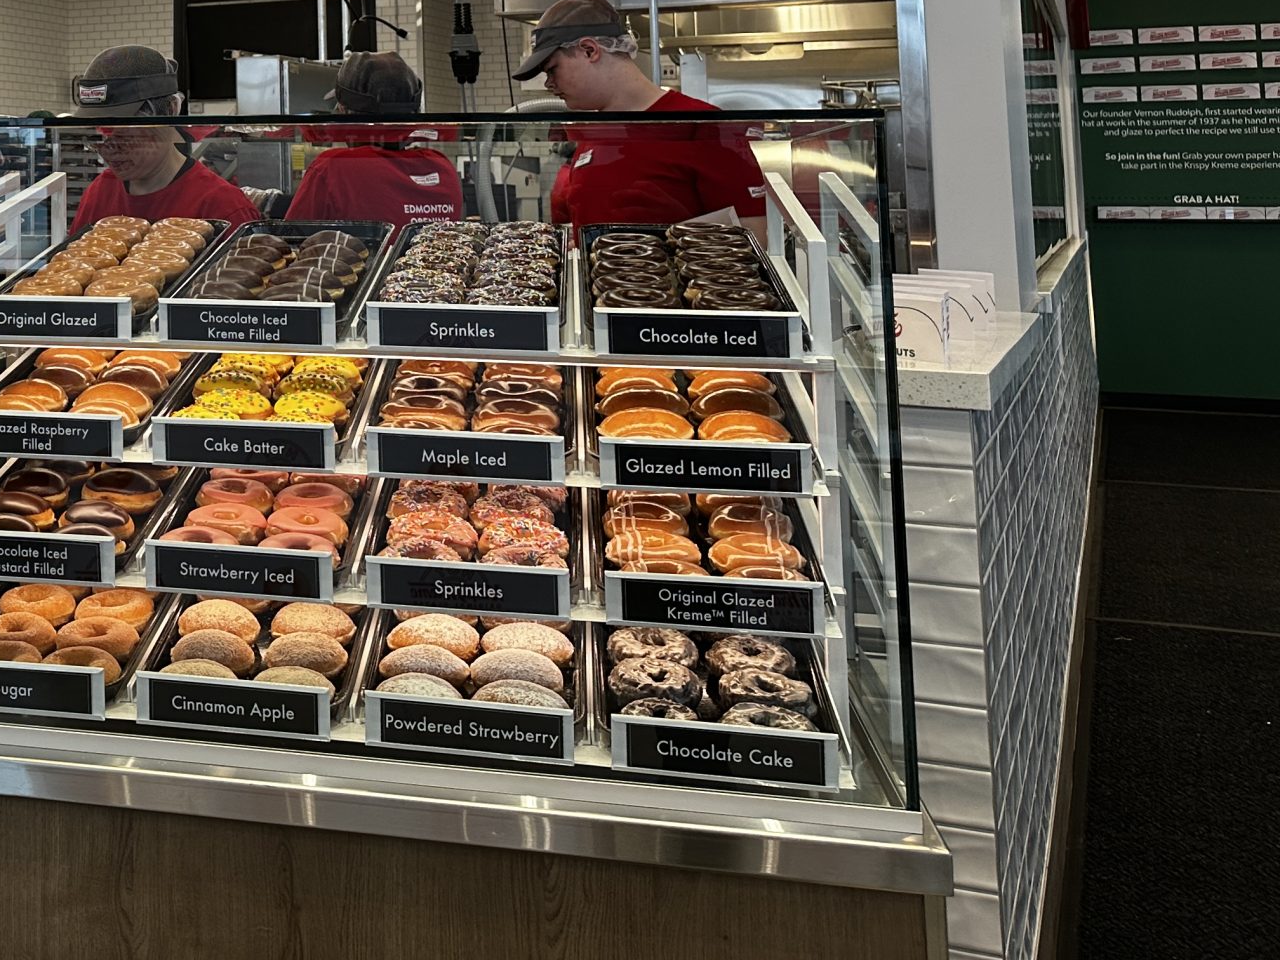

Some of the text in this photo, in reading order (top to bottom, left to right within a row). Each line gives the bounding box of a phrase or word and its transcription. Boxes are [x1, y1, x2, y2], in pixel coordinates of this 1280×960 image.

[1083, 110, 1098, 118] Our
[1100, 109, 1132, 117] founder
[1205, 108, 1221, 116] first
[1223, 107, 1253, 115] started
[1118, 153, 1135, 162] join
[1146, 152, 1161, 160] the
[1204, 153, 1223, 161] your
[1246, 153, 1271, 161] paper
[1174, 195, 1239, 203] GRAB A HAT!
[404, 204, 454, 213] EDMONTON
[51, 312, 97, 326] Glazed
[200, 311, 287, 325] Chocolate Iced
[208, 327, 280, 341] Kreme Filled
[430, 322, 495, 340] Sprinkles
[639, 328, 757, 345] Chocolate Iced
[31, 423, 89, 439] Raspberry
[23, 438, 52, 451] Filled
[204, 438, 284, 454] Cake Batter
[422, 449, 506, 468] Maple Iced
[626, 458, 791, 479] Glazed Lemon Filled
[43, 547, 68, 559] Iced
[34, 562, 64, 576] Filled
[180, 562, 294, 584] Strawberry Iced
[435, 580, 503, 599] Sprinkles
[658, 588, 774, 608] Original Glazed
[730, 610, 767, 625] Filled
[172, 695, 294, 723] Cinnamon Apple
[386, 714, 559, 749] Powdered Strawberry
[657, 740, 793, 768] Chocolate Cake
